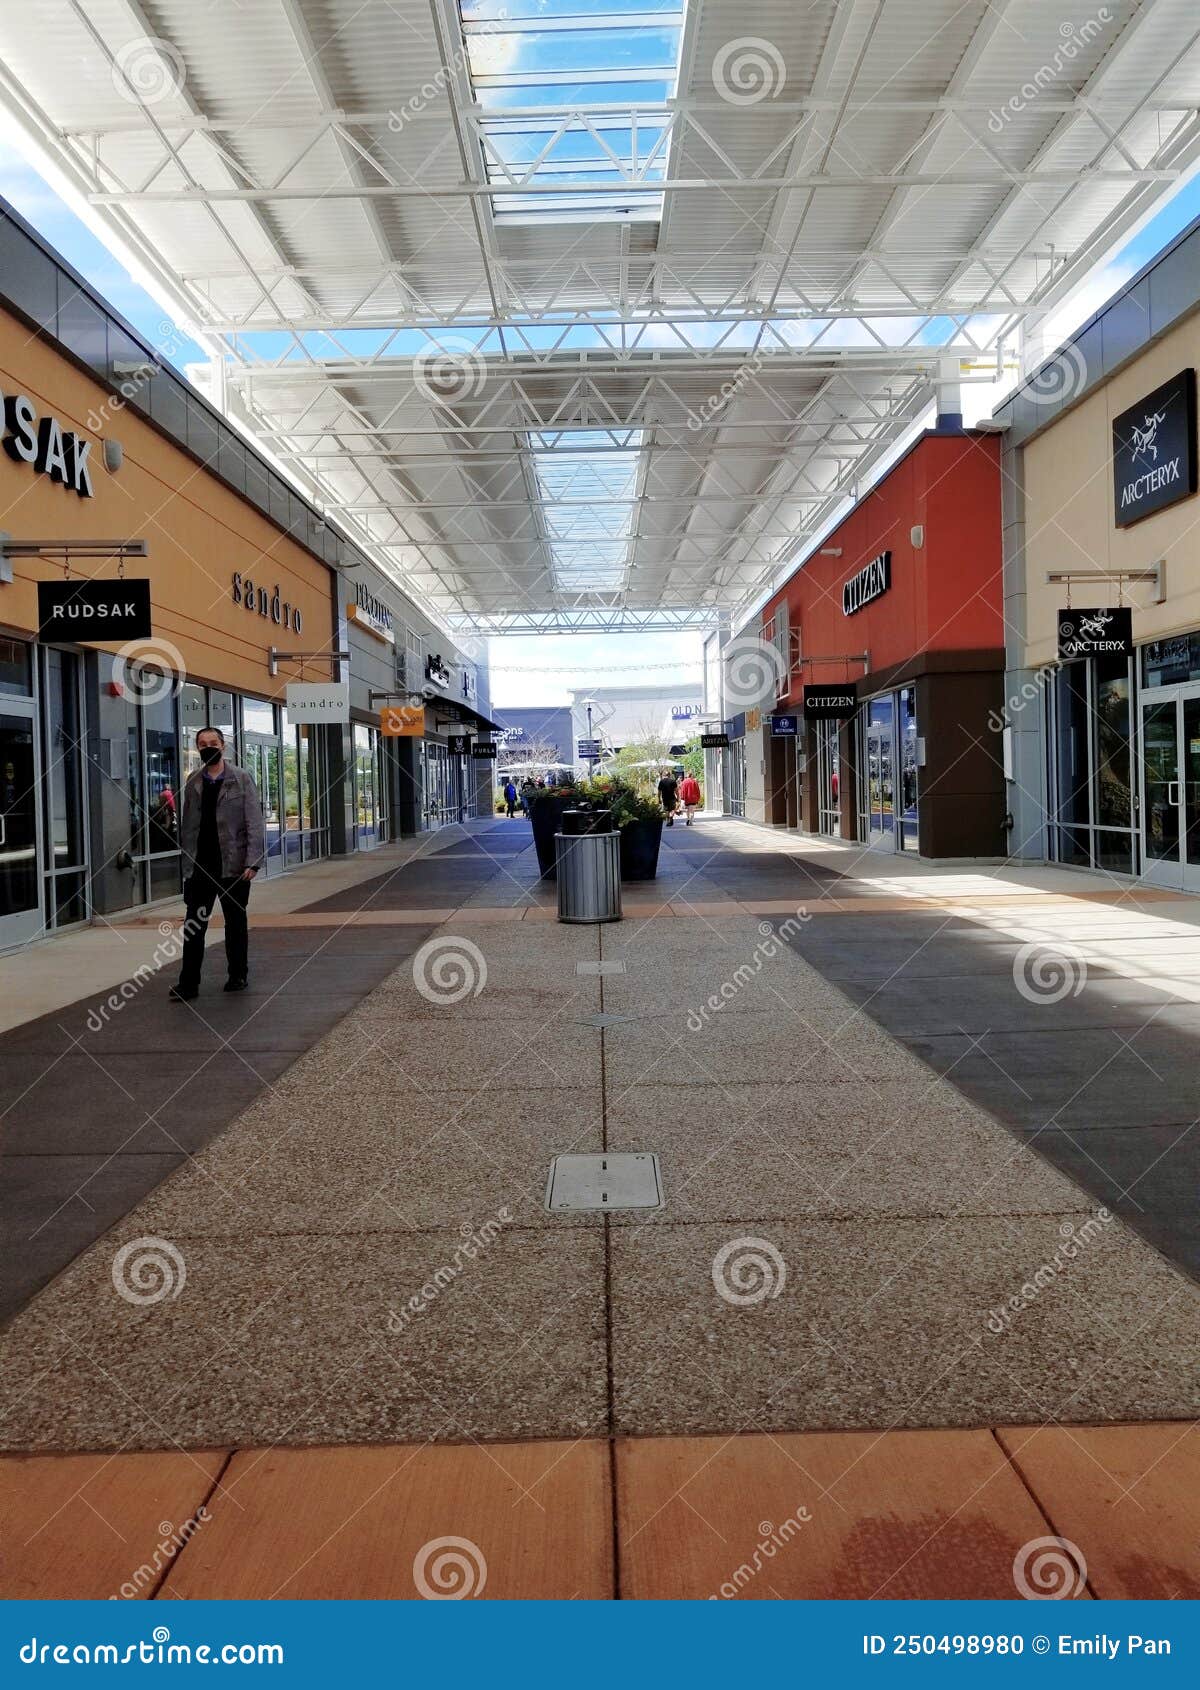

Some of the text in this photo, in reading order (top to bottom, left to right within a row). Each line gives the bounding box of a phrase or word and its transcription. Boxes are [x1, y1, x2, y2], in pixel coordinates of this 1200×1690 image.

[0, 388, 94, 497] SAK
[1120, 457, 1180, 508] ARC'TERYX
[842, 551, 889, 616] CITIZEN
[53, 603, 137, 618] RUDSAK
[232, 571, 302, 634] sandro
[1067, 640, 1125, 651] ARC'TERYX
[291, 699, 344, 709] sandro
[806, 696, 855, 708] CITIZEN
